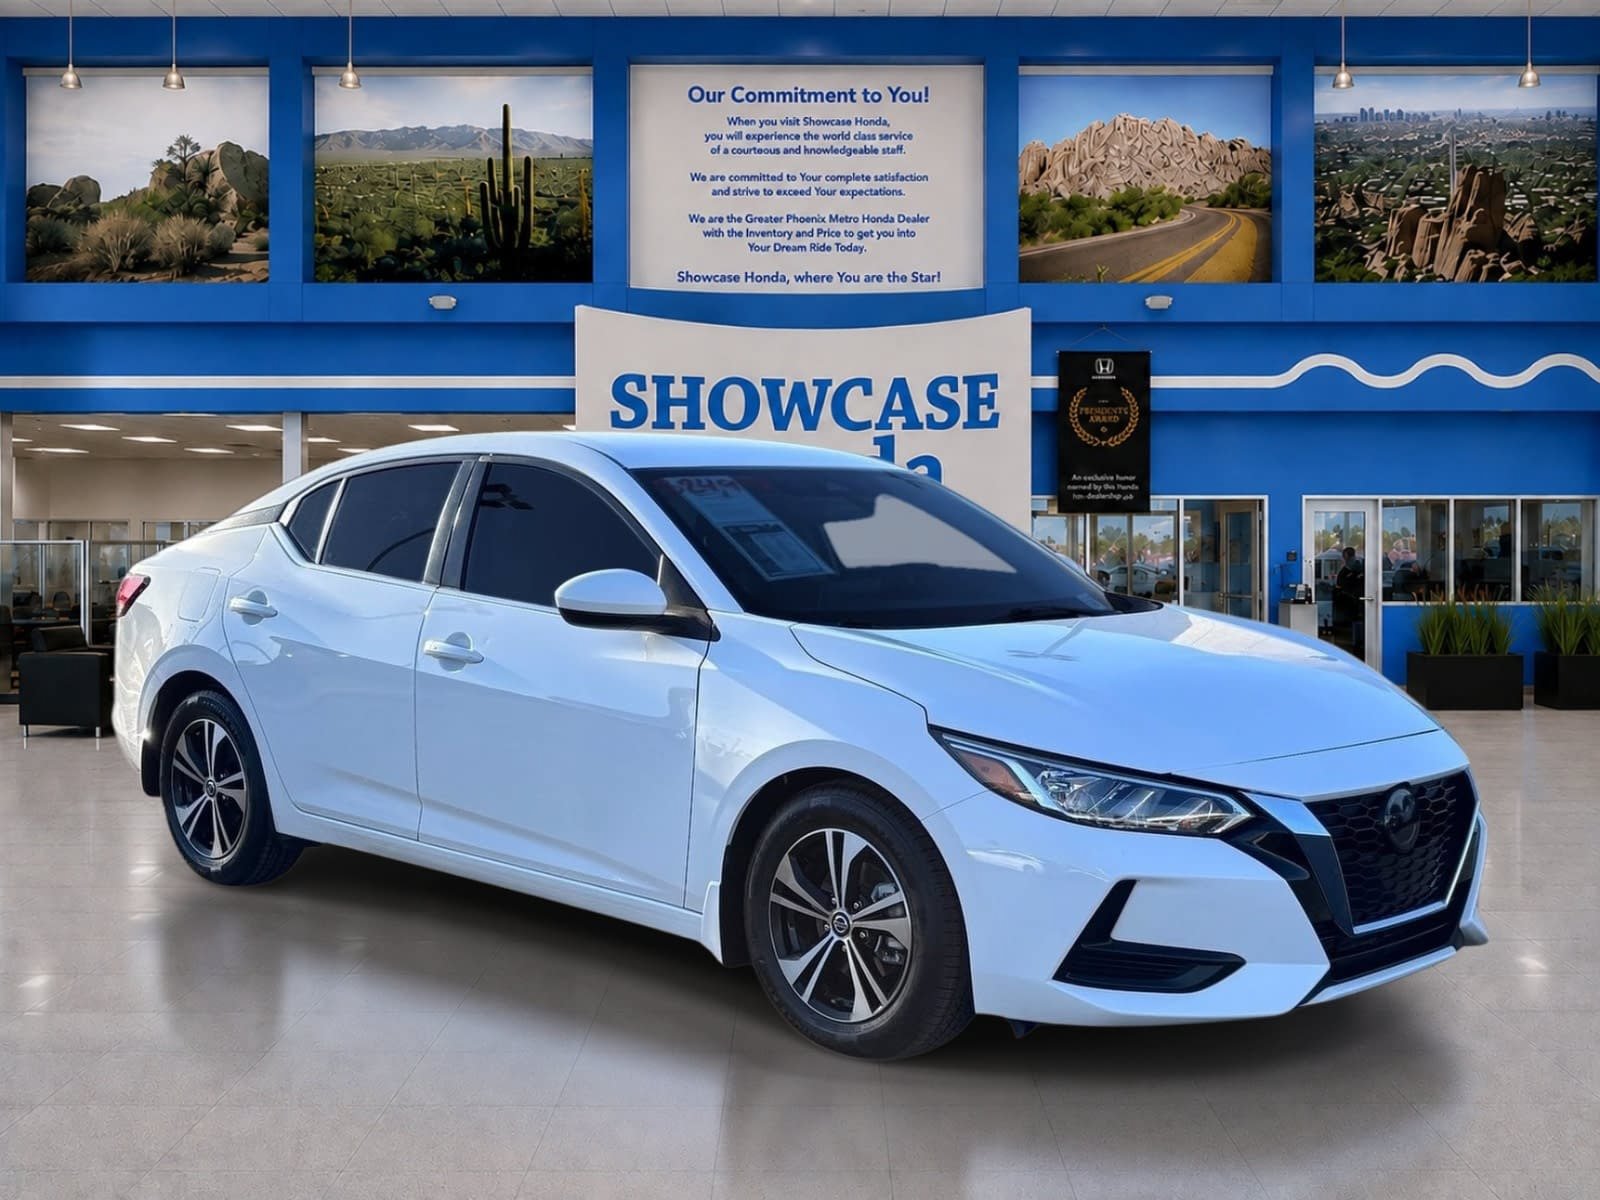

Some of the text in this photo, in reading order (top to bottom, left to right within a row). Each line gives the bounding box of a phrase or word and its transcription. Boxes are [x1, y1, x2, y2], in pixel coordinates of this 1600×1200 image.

[687, 85, 930, 104] Our Commitment to You!
[726, 116, 891, 129] When you visit Showcase Honda,
[704, 130, 914, 144] you will experience the world class service
[709, 144, 721, 155] of
[722, 147, 730, 155] a
[730, 146, 782, 156] courteous
[782, 144, 802, 155] and
[881, 144, 906, 155] staff.
[689, 171, 929, 185] We are committed to Your complete satisfaction
[711, 186, 906, 200] and strive to exceed Your expectations.
[688, 213, 931, 224] We are the Greater Phoenix Metro Honda Dealer
[702, 227, 917, 241] with the Inventory and Price to get you into
[747, 242, 867, 255] Your Dream Ride Today.
[677, 270, 941, 286] Showcase Honda, where You are the Star!
[610, 373, 1000, 431] SHOWCASE
